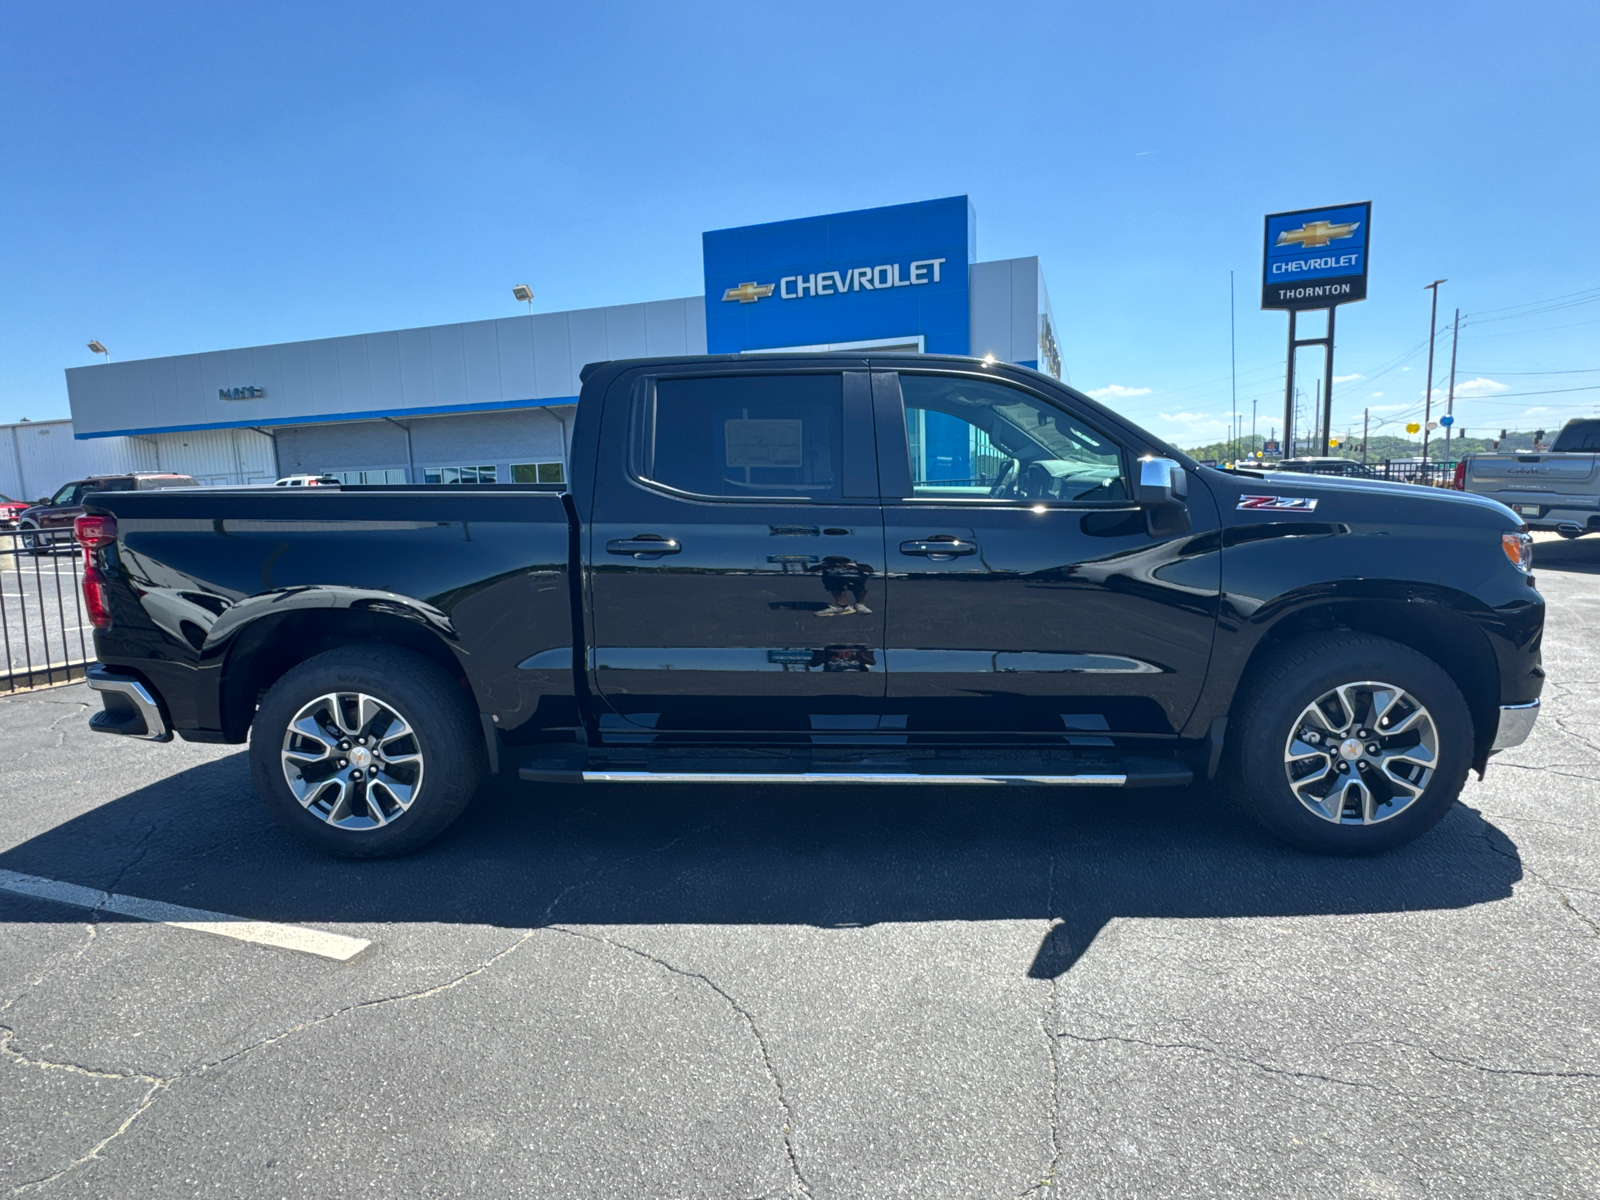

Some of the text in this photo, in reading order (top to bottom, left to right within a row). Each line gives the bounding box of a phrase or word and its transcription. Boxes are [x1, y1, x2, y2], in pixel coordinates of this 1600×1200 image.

[1272, 254, 1359, 274] CHEVROLET
[779, 257, 946, 300] CHEVROLET
[1278, 283, 1351, 300] THORNTON
[1235, 494, 1319, 513] Z71
